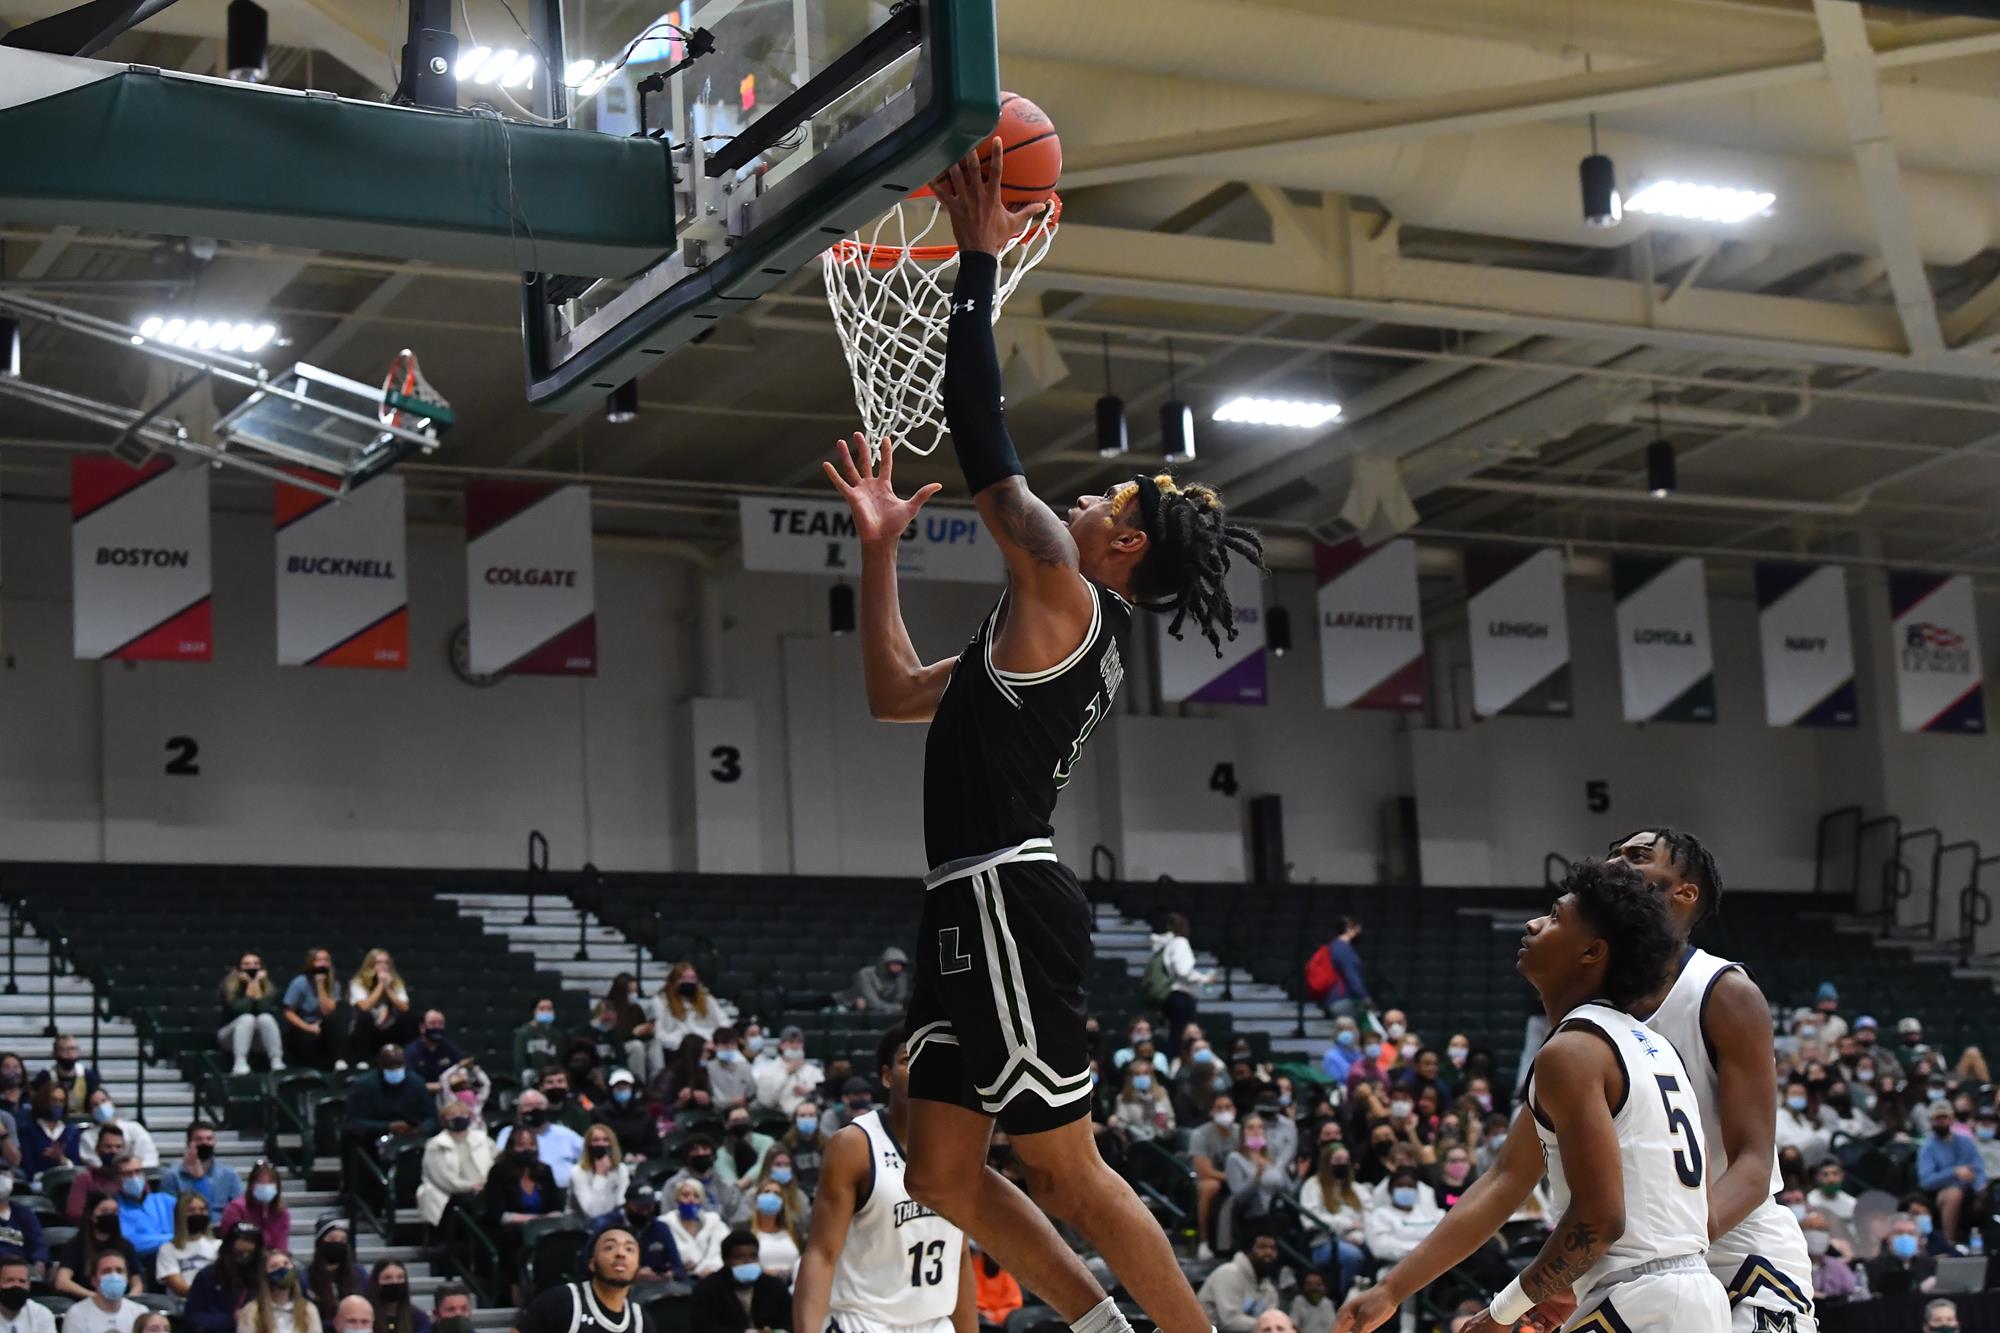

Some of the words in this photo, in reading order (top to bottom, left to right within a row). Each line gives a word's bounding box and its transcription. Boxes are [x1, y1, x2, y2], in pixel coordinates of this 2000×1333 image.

[769, 508, 918, 542] TEAMG
[926, 517, 978, 545] UP!
[96, 547, 189, 568] BOSTON
[287, 555, 395, 579] BUCKNELL
[484, 567, 576, 588] COLGATE
[1325, 612, 1414, 632] LAFAYETTE
[1488, 621, 1549, 638] LEHIGH
[1633, 629, 1694, 646] LOYOLA
[165, 736, 199, 776] 2
[711, 746, 741, 783] 3
[1210, 762, 1239, 797] 4
[1586, 780, 1610, 814] 5
[939, 926, 971, 975] L
[1653, 1072, 1704, 1190] 5
[908, 1240, 946, 1287] 13
